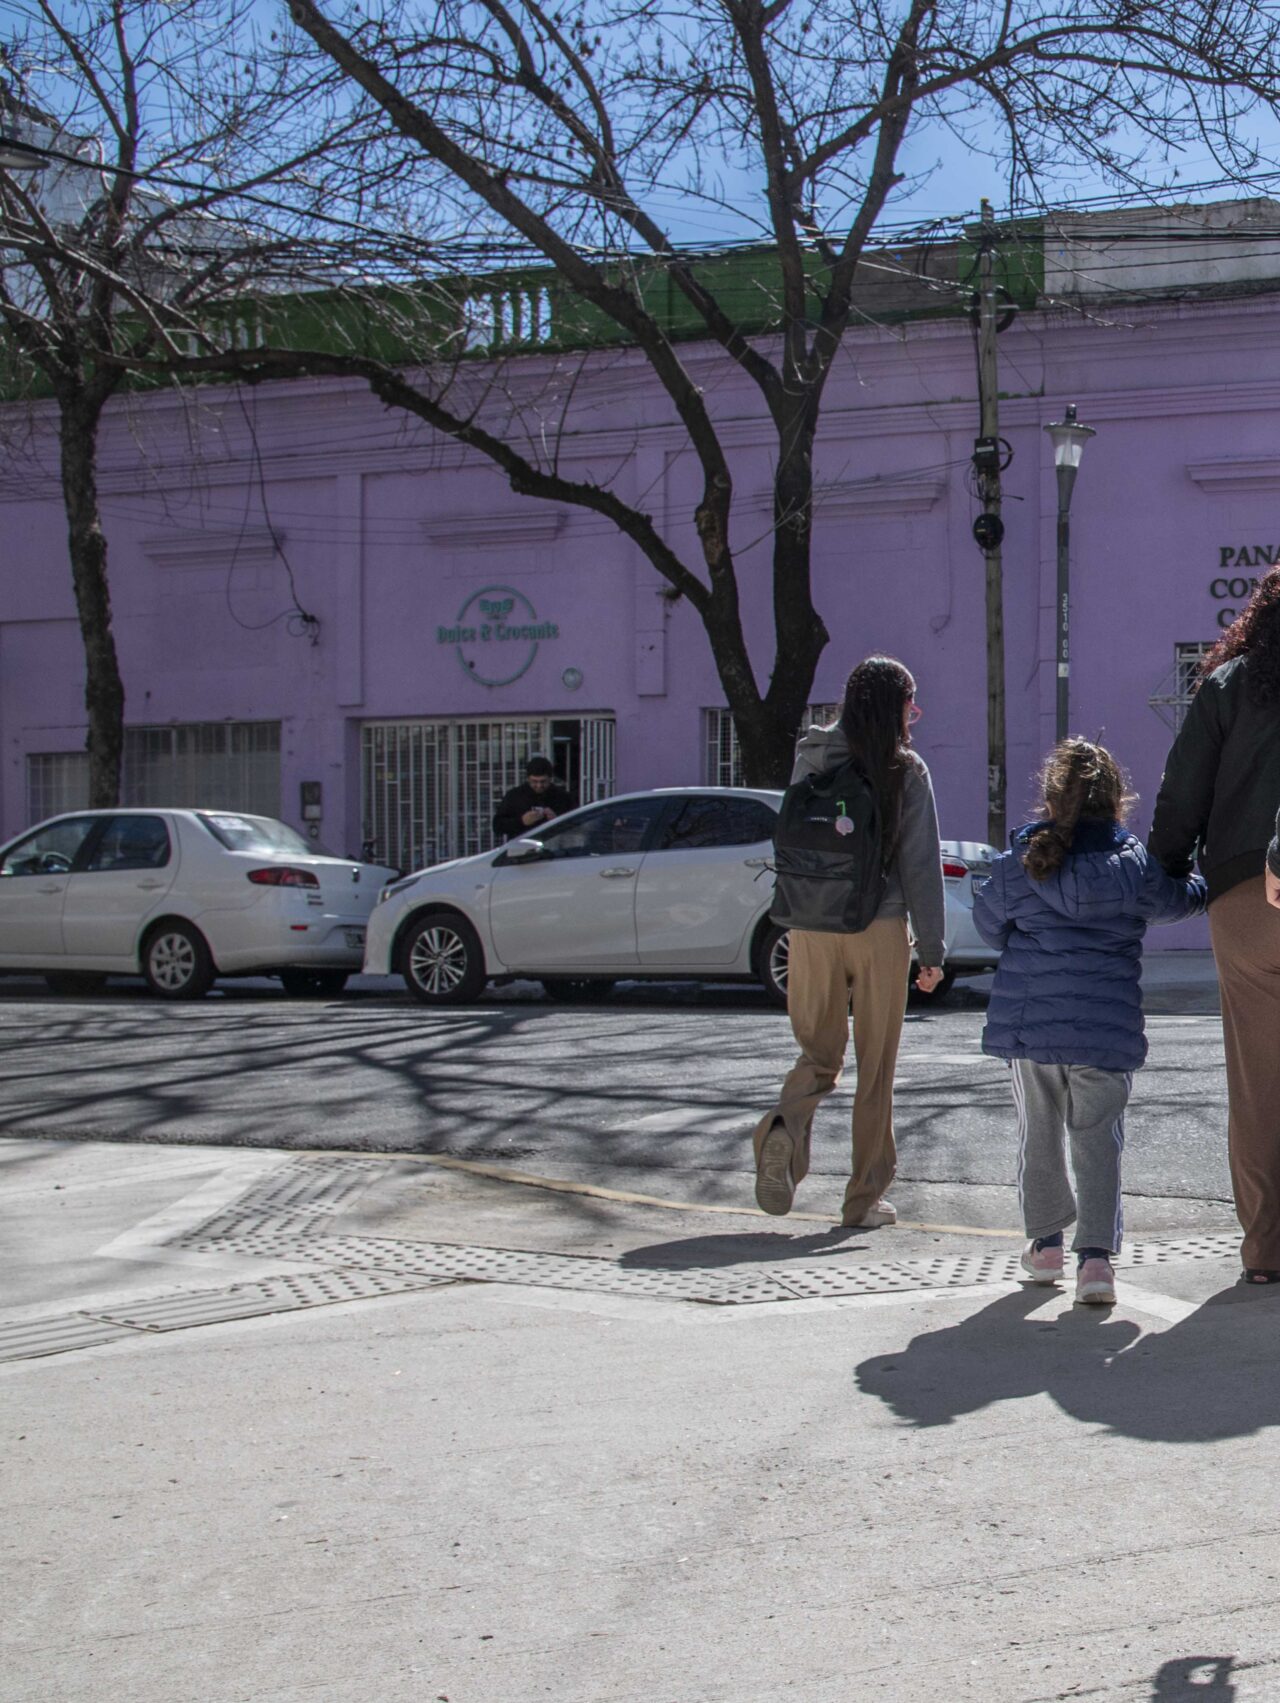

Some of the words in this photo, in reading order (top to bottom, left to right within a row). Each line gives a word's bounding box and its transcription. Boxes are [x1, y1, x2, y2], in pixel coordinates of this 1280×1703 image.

[437, 624, 477, 645] Dulce
[481, 623, 492, 641] &
[495, 620, 560, 642] Crocante
